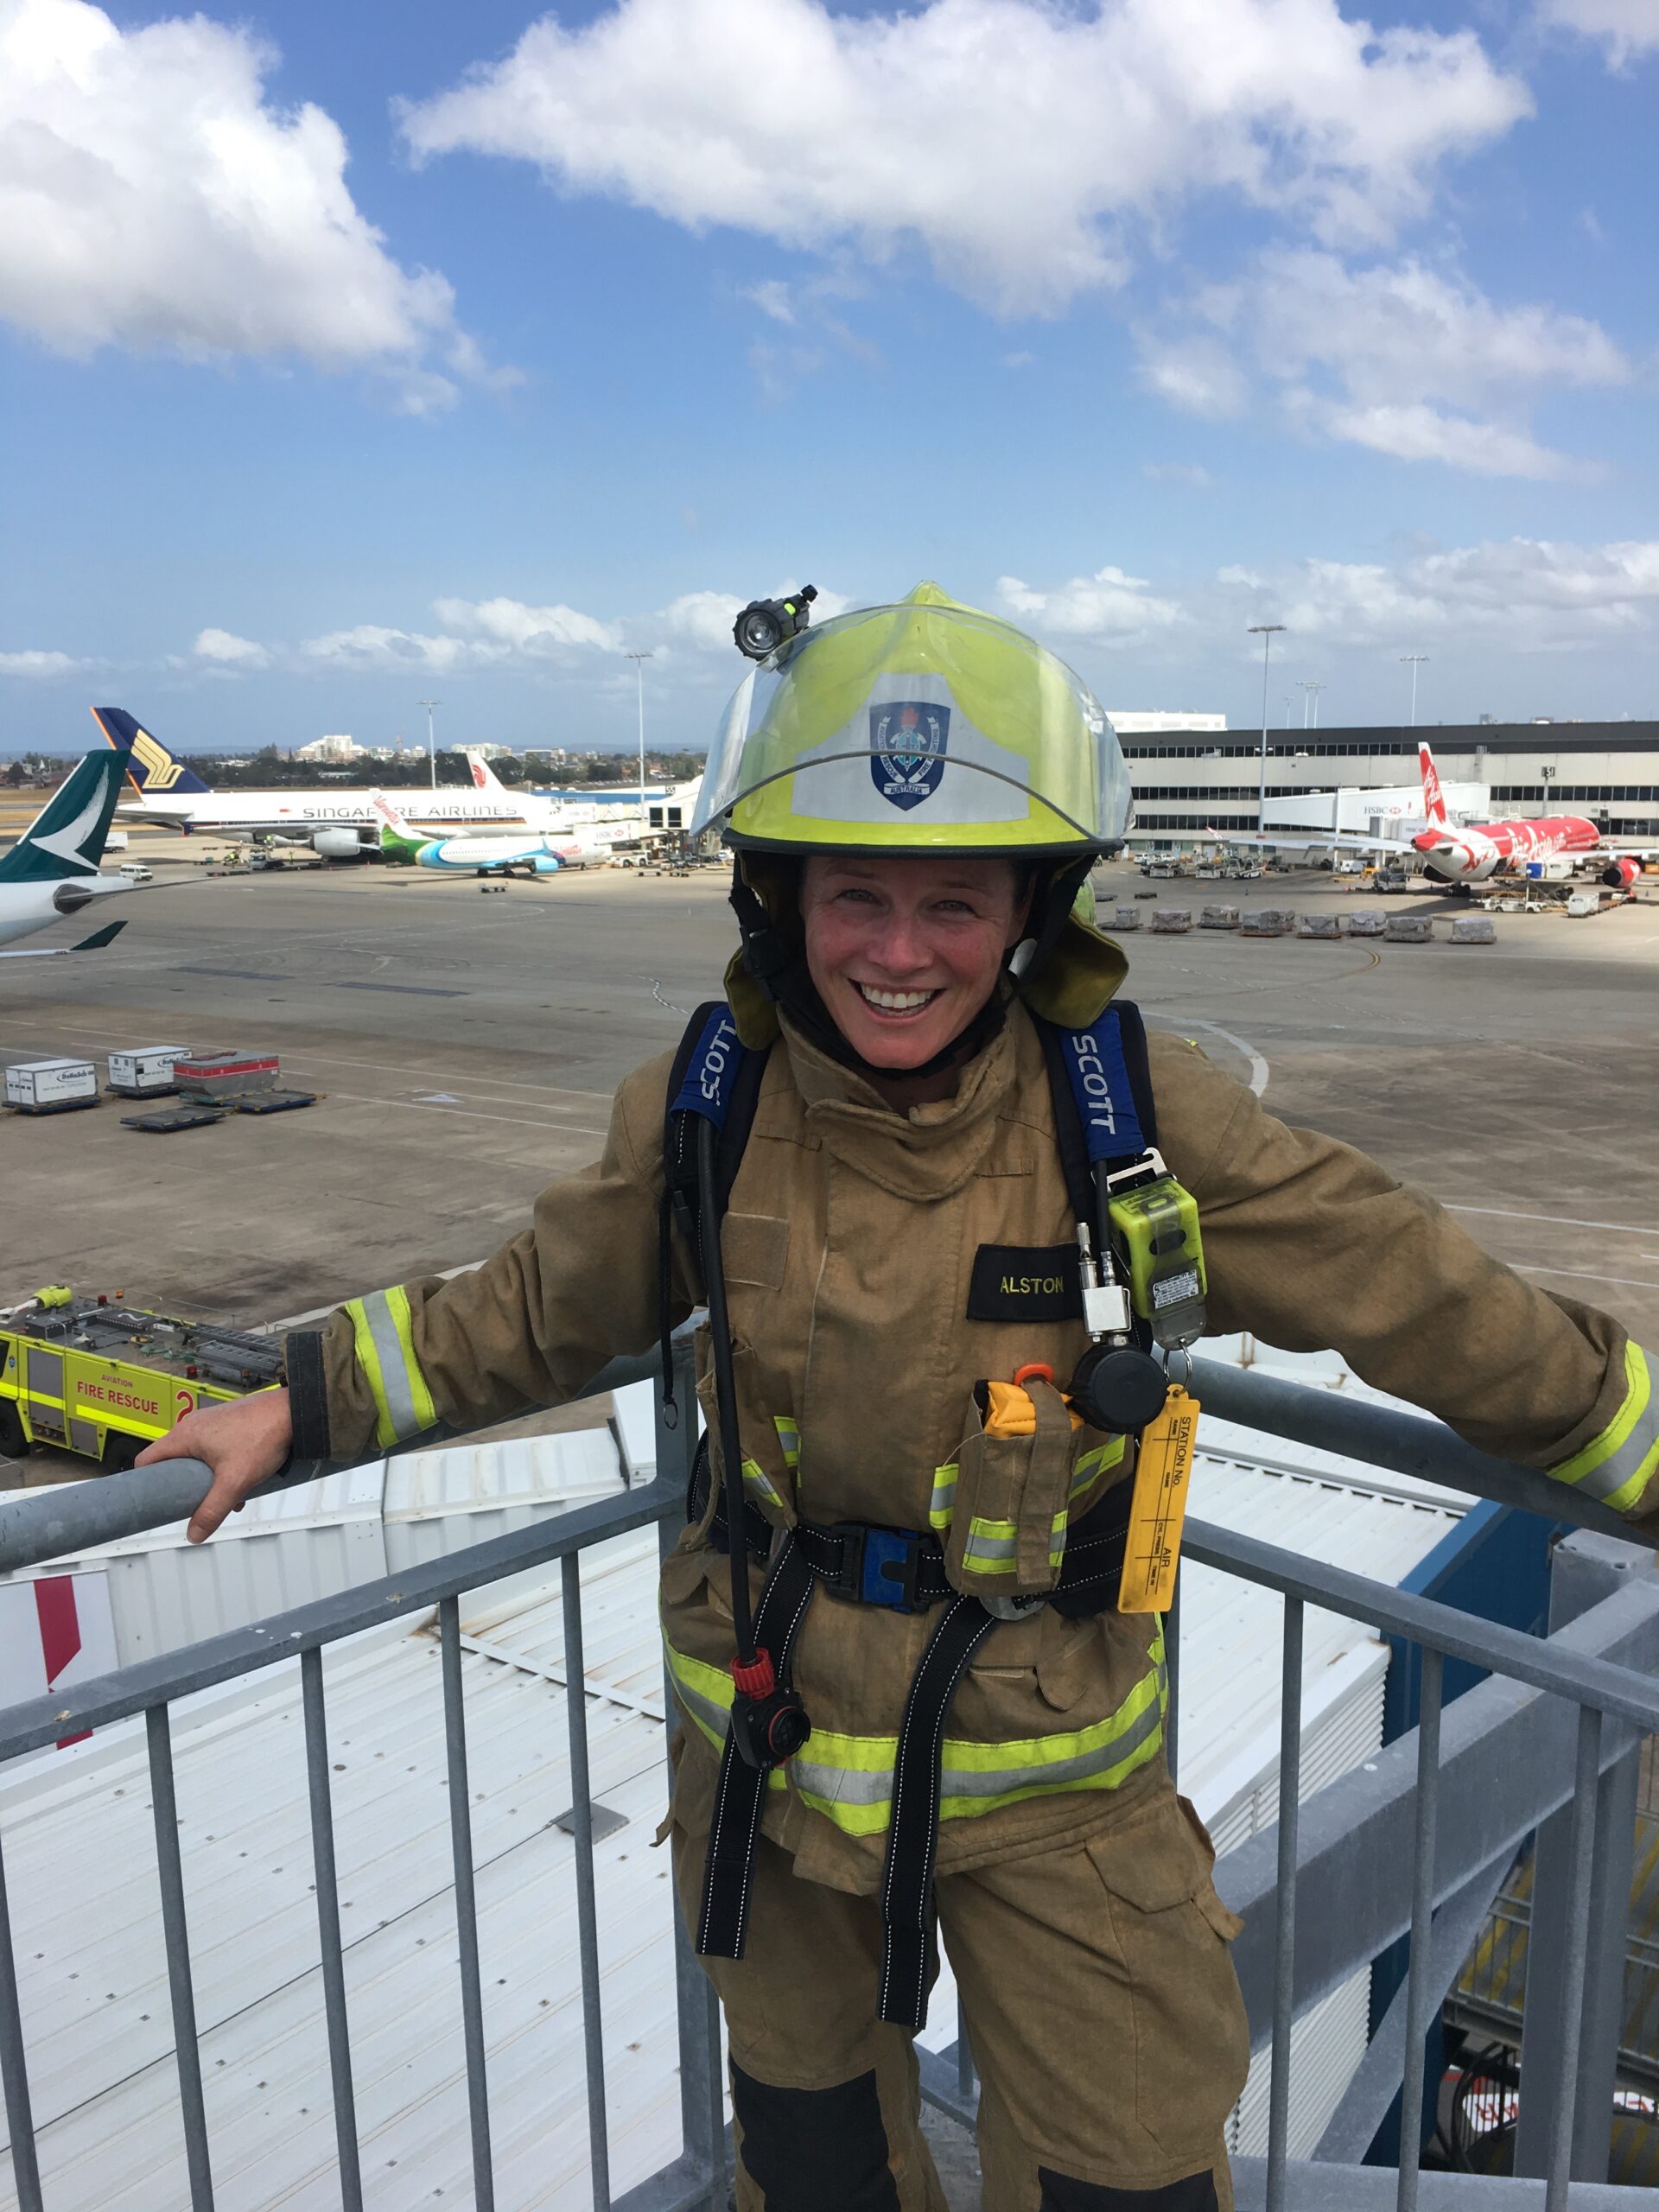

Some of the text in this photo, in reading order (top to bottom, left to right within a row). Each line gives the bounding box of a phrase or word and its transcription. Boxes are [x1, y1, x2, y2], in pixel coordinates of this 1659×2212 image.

[881, 756, 899, 779] RESCUE
[918, 762, 931, 777] FIRE
[890, 785, 922, 794] AUSTRALIA
[303, 805, 518, 818] SINGAPRE AIRLINES
[701, 1020, 738, 1106] SCOTT
[1071, 1034, 1116, 1135] SCOTT
[1000, 1275, 1065, 1294] ALSTON
[101, 1374, 133, 1388] AVIATION
[77, 1381, 159, 1415] FIRE RESCUE
[1172, 1416, 1192, 1488] STATION No.
[1161, 1547, 1172, 1567] AIR
